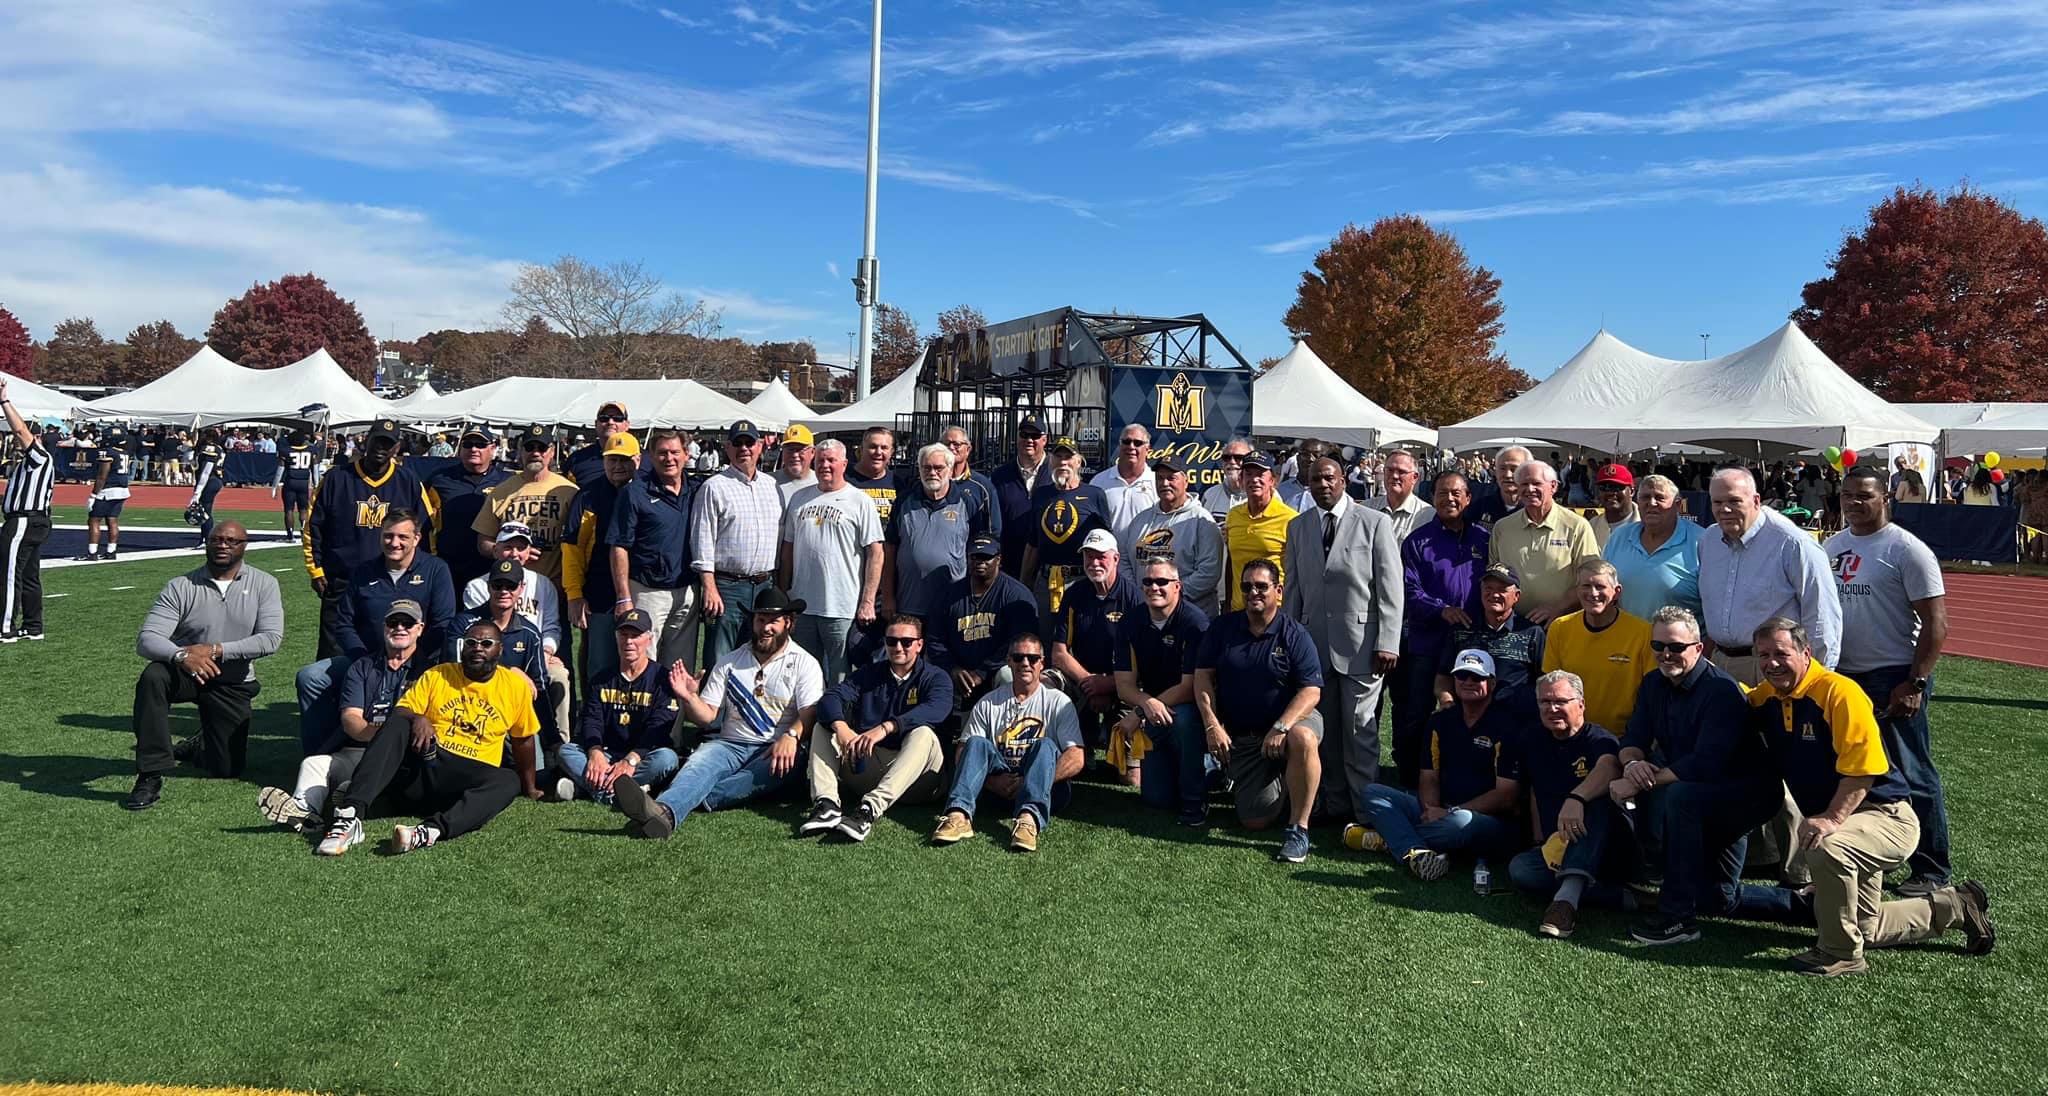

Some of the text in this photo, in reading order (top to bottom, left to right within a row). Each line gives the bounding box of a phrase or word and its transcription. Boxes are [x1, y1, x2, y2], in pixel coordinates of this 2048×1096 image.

[995, 329, 1036, 358] STARTING
[1038, 323, 1063, 349] GATE
[289, 452, 311, 469] 30
[1176, 440, 1223, 465] Wo
[505, 501, 560, 520] RACER
[825, 505, 843, 525] STATE
[476, 698, 500, 722] STATE
[442, 740, 479, 758] RACERS
